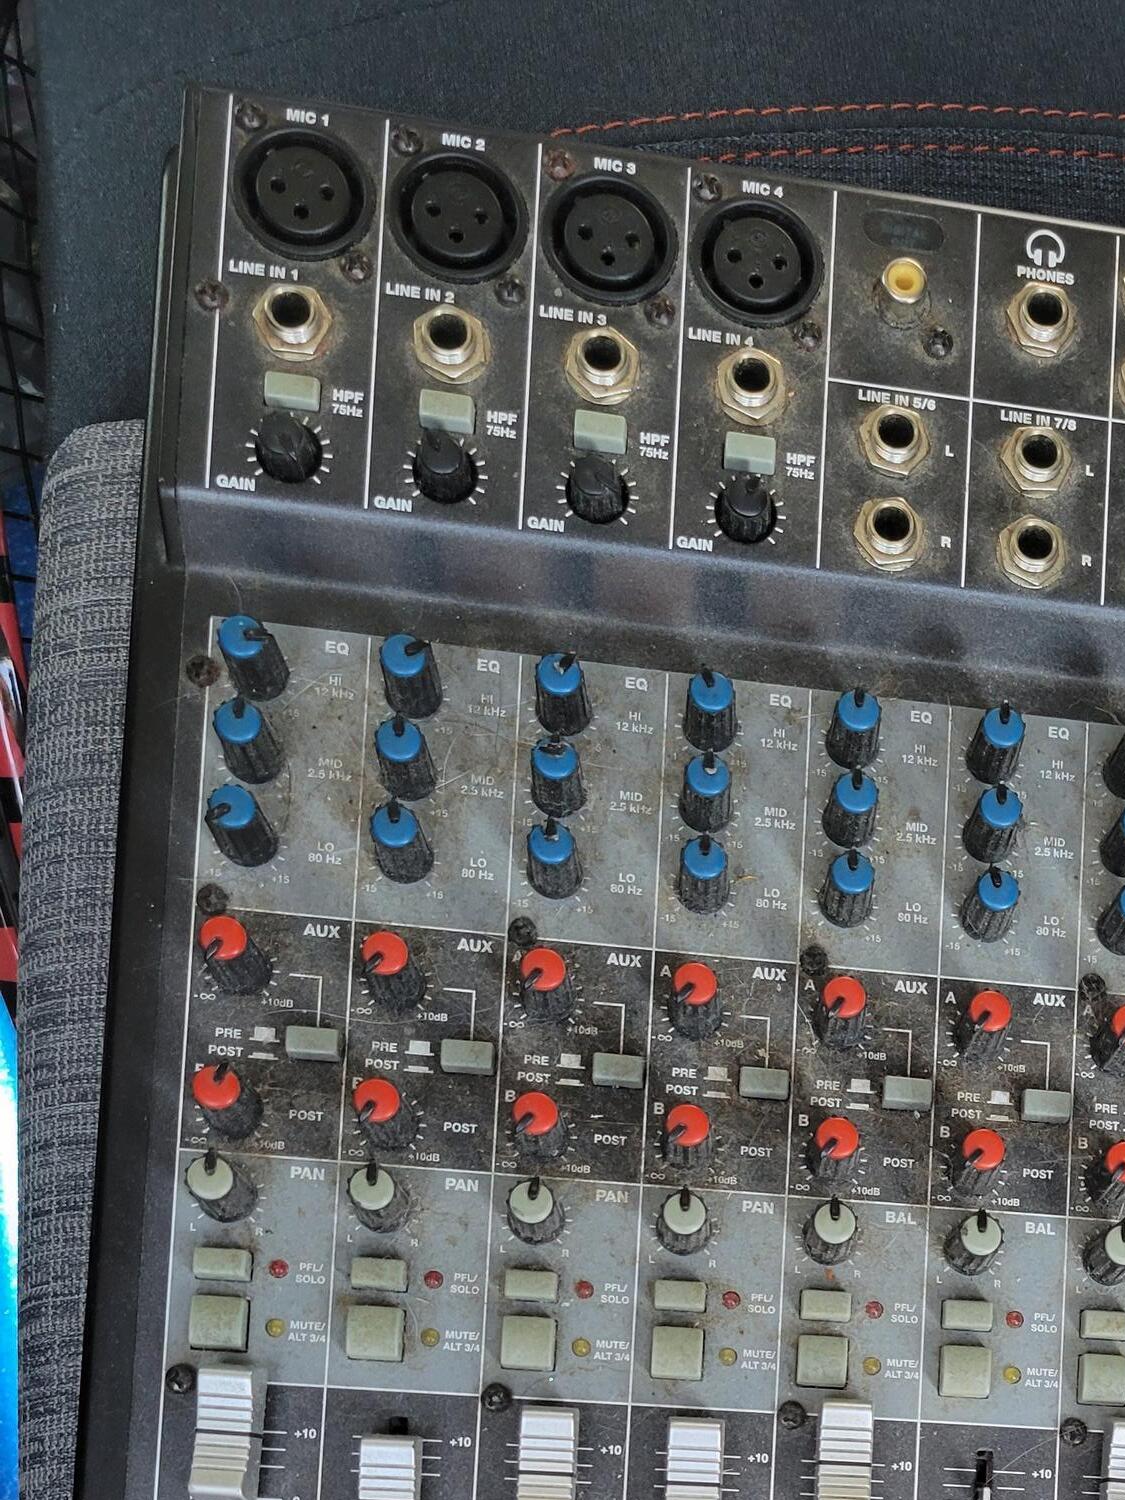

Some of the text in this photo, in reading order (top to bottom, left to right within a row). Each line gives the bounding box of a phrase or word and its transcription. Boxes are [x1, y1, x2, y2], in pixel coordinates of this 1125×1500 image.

[287, 108, 329, 126] MIC 1
[442, 133, 485, 151] MIC 2
[594, 157, 636, 174] MIC 3
[743, 181, 784, 199] MIC 4
[229, 259, 298, 280] LINE IN 1
[1017, 266, 1074, 285] PHONES
[386, 282, 454, 303] LINE IN 2
[540, 305, 606, 325] LINE IN 3
[689, 327, 754, 347] LINE IN 4
[332, 390, 364, 405] HPF
[858, 389, 935, 410] LINE IN 5/6
[332, 403, 362, 417] 75Hz
[487, 412, 518, 426] HPF
[1001, 410, 1076, 430] LINE IN 7/8
[640, 433, 670, 448] HPF
[787, 453, 815, 466] HPF
[786, 467, 814, 479] 75Hz
[216, 475, 255, 491] GAIN
[374, 496, 412, 512] GAIN
[528, 517, 564, 532] GAIN
[677, 536, 712, 551] GAIN
[326, 641, 349, 655] EQ
[626, 677, 647, 691] EQ
[770, 694, 791, 708] EQ
[1049, 727, 1069, 740] EQ
[765, 807, 787, 817] MID
[755, 817, 795, 830] 2.5 kHz
[470, 858, 486, 867] LO
[303, 924, 340, 938] AUX
[607, 953, 641, 967] AUX
[752, 967, 786, 981] AUX
[1033, 993, 1065, 1007] AUX
[216, 1028, 241, 1039] PRE
[209, 1045, 243, 1057] POST
[291, 1166, 324, 1180] PAN
[743, 1200, 773, 1214] PAN
[1026, 1222, 1055, 1235] BAL
[295, 1429, 316, 1438] +10
